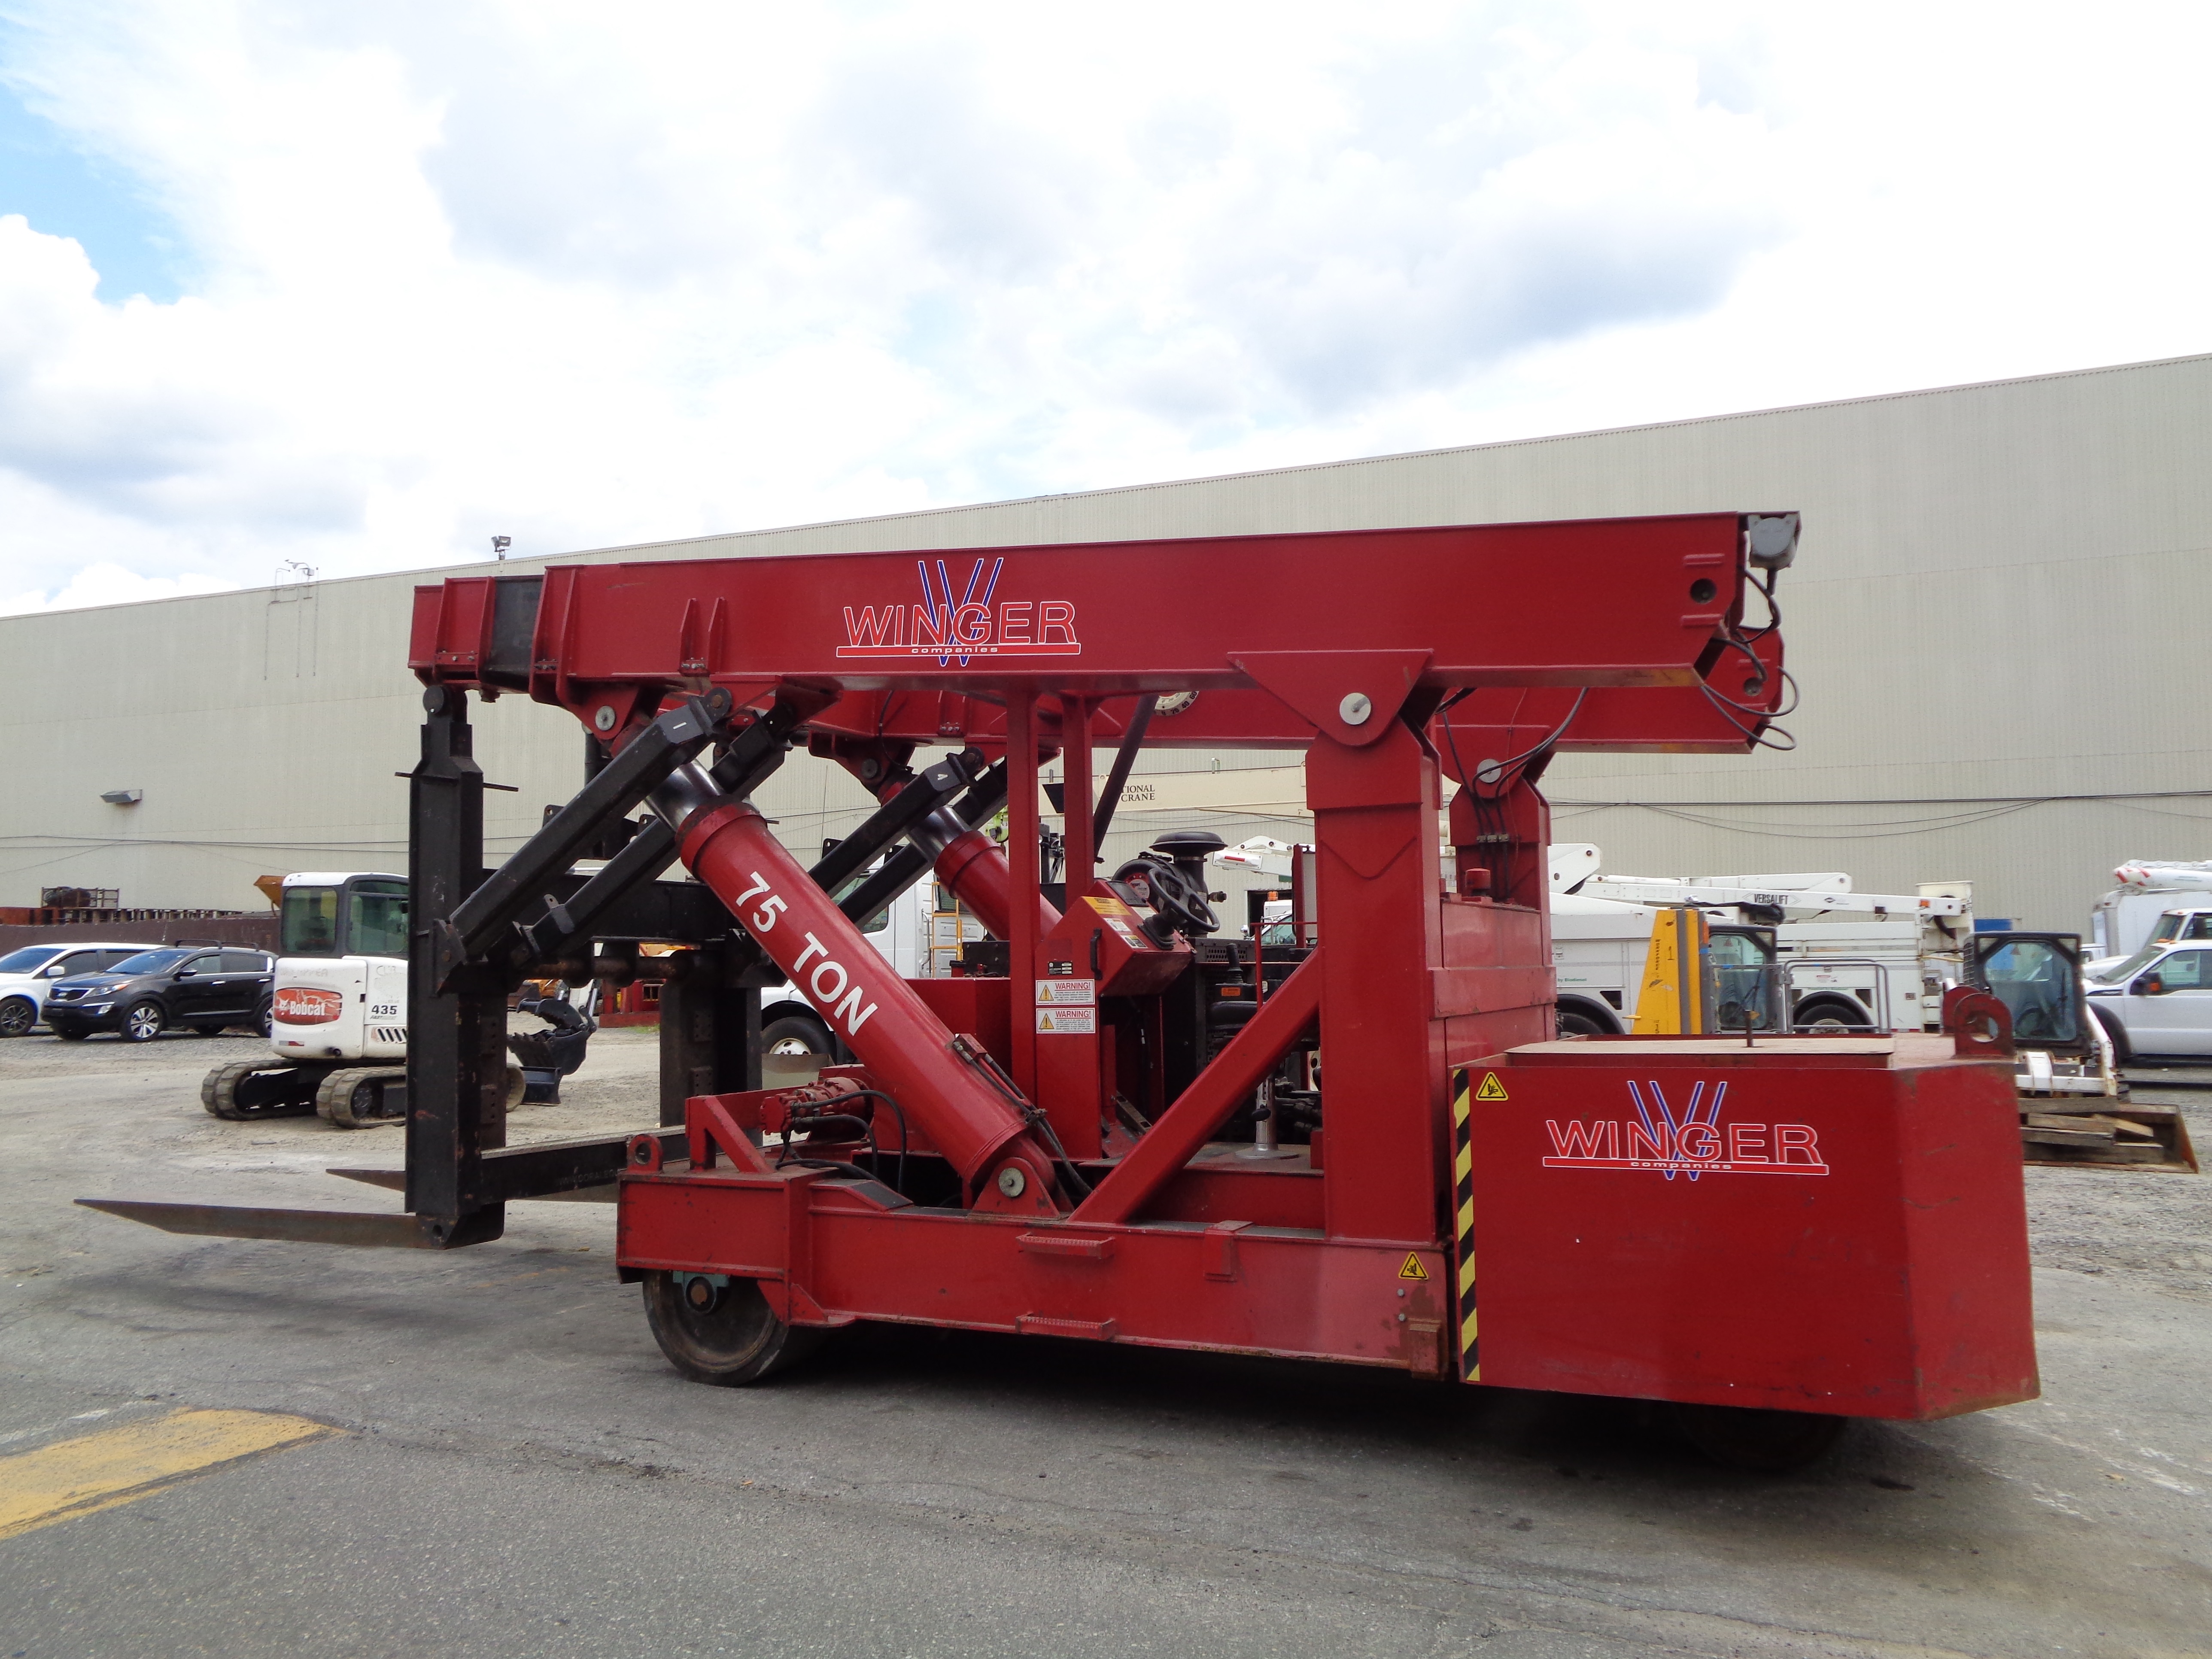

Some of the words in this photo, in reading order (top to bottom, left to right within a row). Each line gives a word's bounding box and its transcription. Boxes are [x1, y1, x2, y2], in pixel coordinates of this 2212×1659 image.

[843, 601, 1077, 646] WINGER
[911, 645, 998, 655] companies
[1121, 793, 1155, 802] CRANE
[1754, 893, 1789, 905] VERSALIFT
[736, 871, 789, 932] 75
[793, 931, 878, 1036] TON
[290, 1001, 326, 1016] Bobcat
[371, 1005, 398, 1015] 435
[1546, 1120, 1824, 1164] WINGER
[1631, 1161, 1732, 1170] companies
